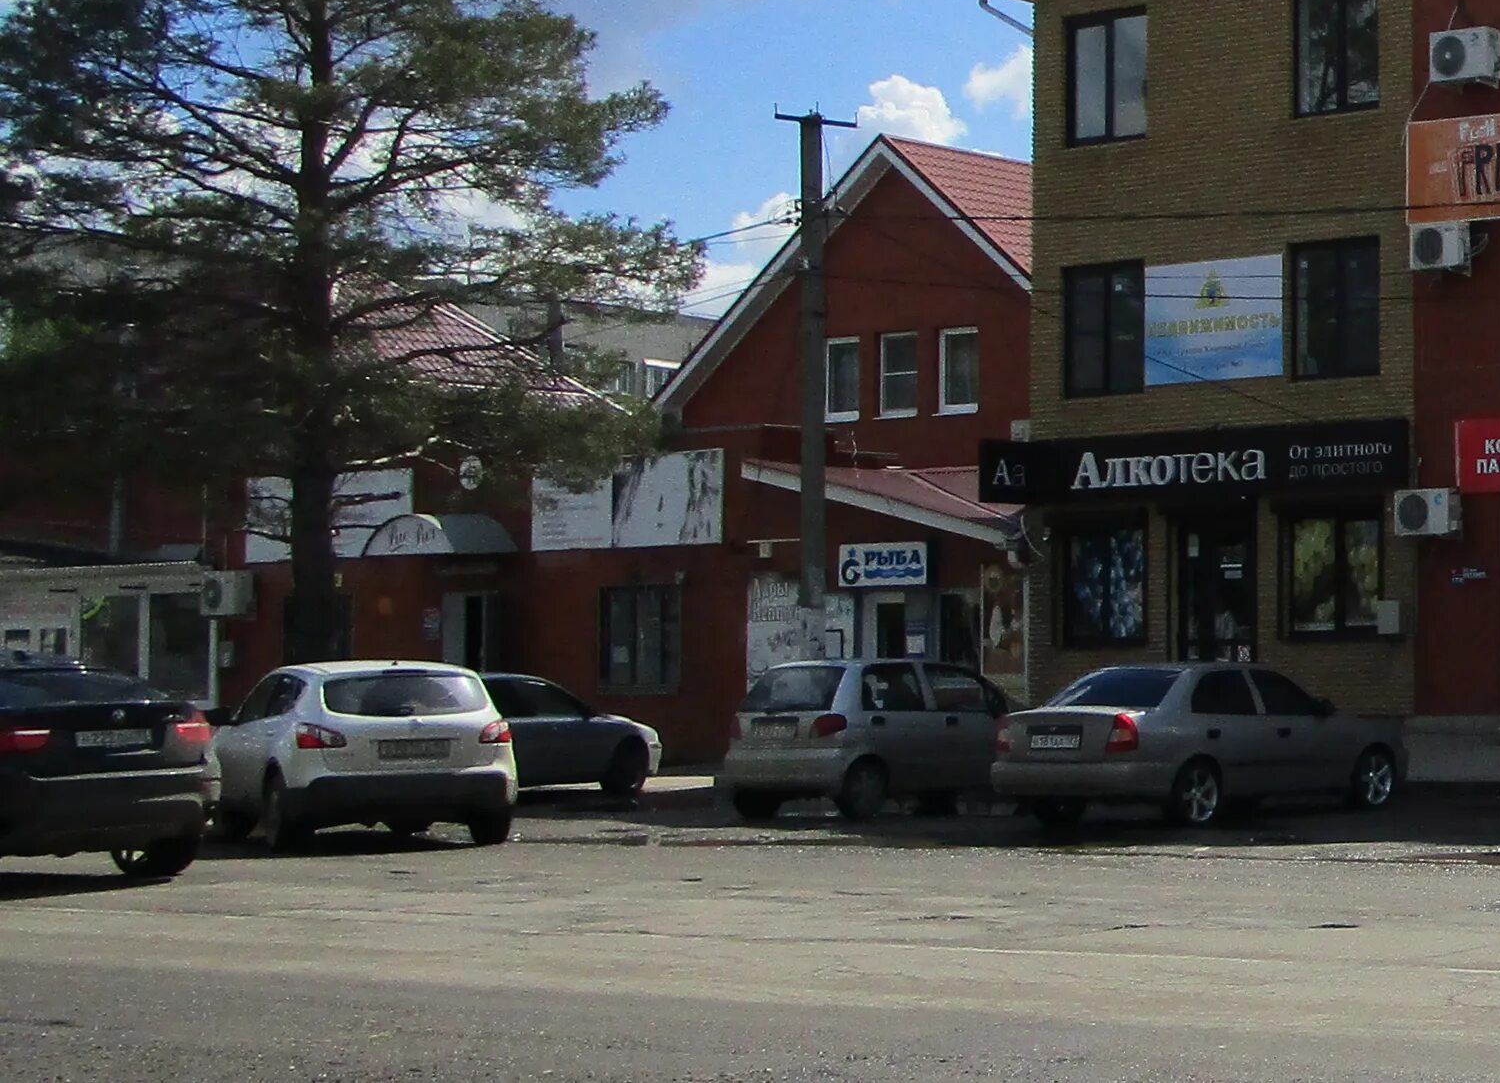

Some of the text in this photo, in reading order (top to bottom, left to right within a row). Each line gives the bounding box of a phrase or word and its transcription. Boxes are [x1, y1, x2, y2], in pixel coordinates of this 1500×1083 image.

[1289, 442, 1393, 460] От элитного
[1071, 448, 1267, 490] Алкотека
[1312, 460, 1384, 479] простого
[864, 548, 922, 567] РЫБА
